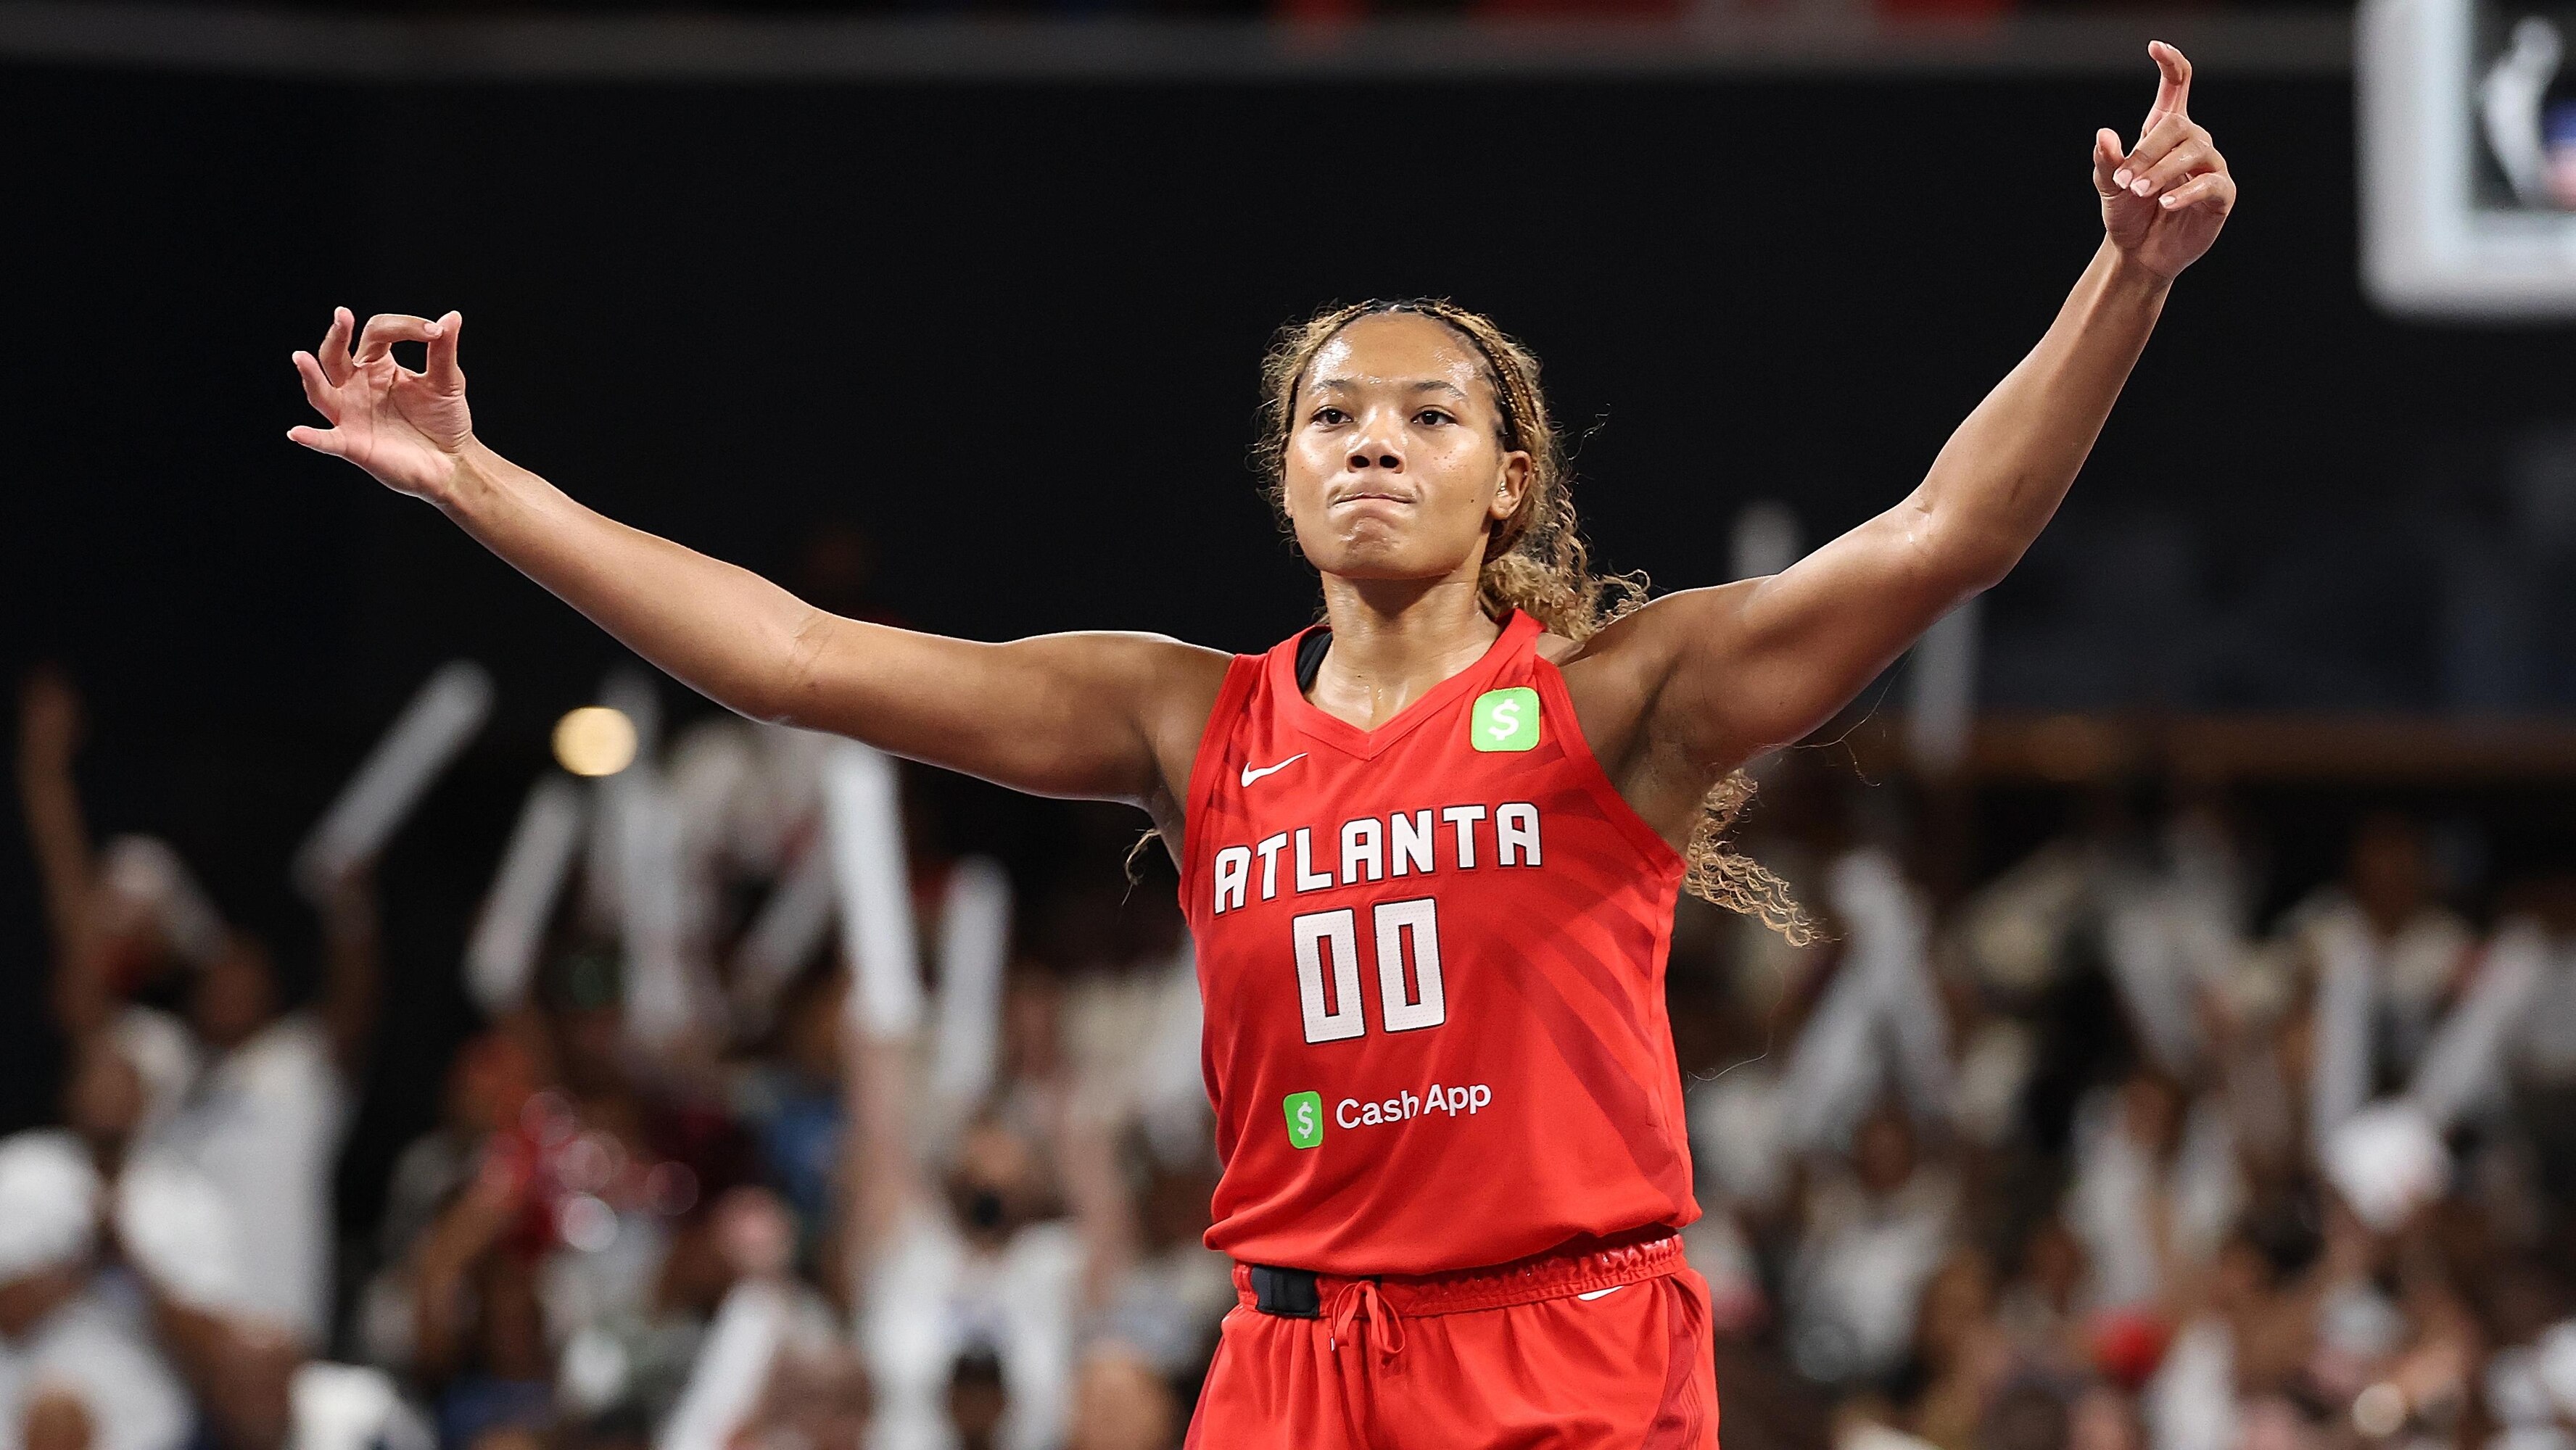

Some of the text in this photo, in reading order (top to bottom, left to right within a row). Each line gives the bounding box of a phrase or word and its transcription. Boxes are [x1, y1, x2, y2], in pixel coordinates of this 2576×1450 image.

[1488, 698, 1522, 742] $
[1214, 803, 1542, 914] ATLANTA
[1292, 898, 1445, 1044] 00
[1335, 1090, 1419, 1130] Cash
[1423, 1083, 1492, 1117] App
